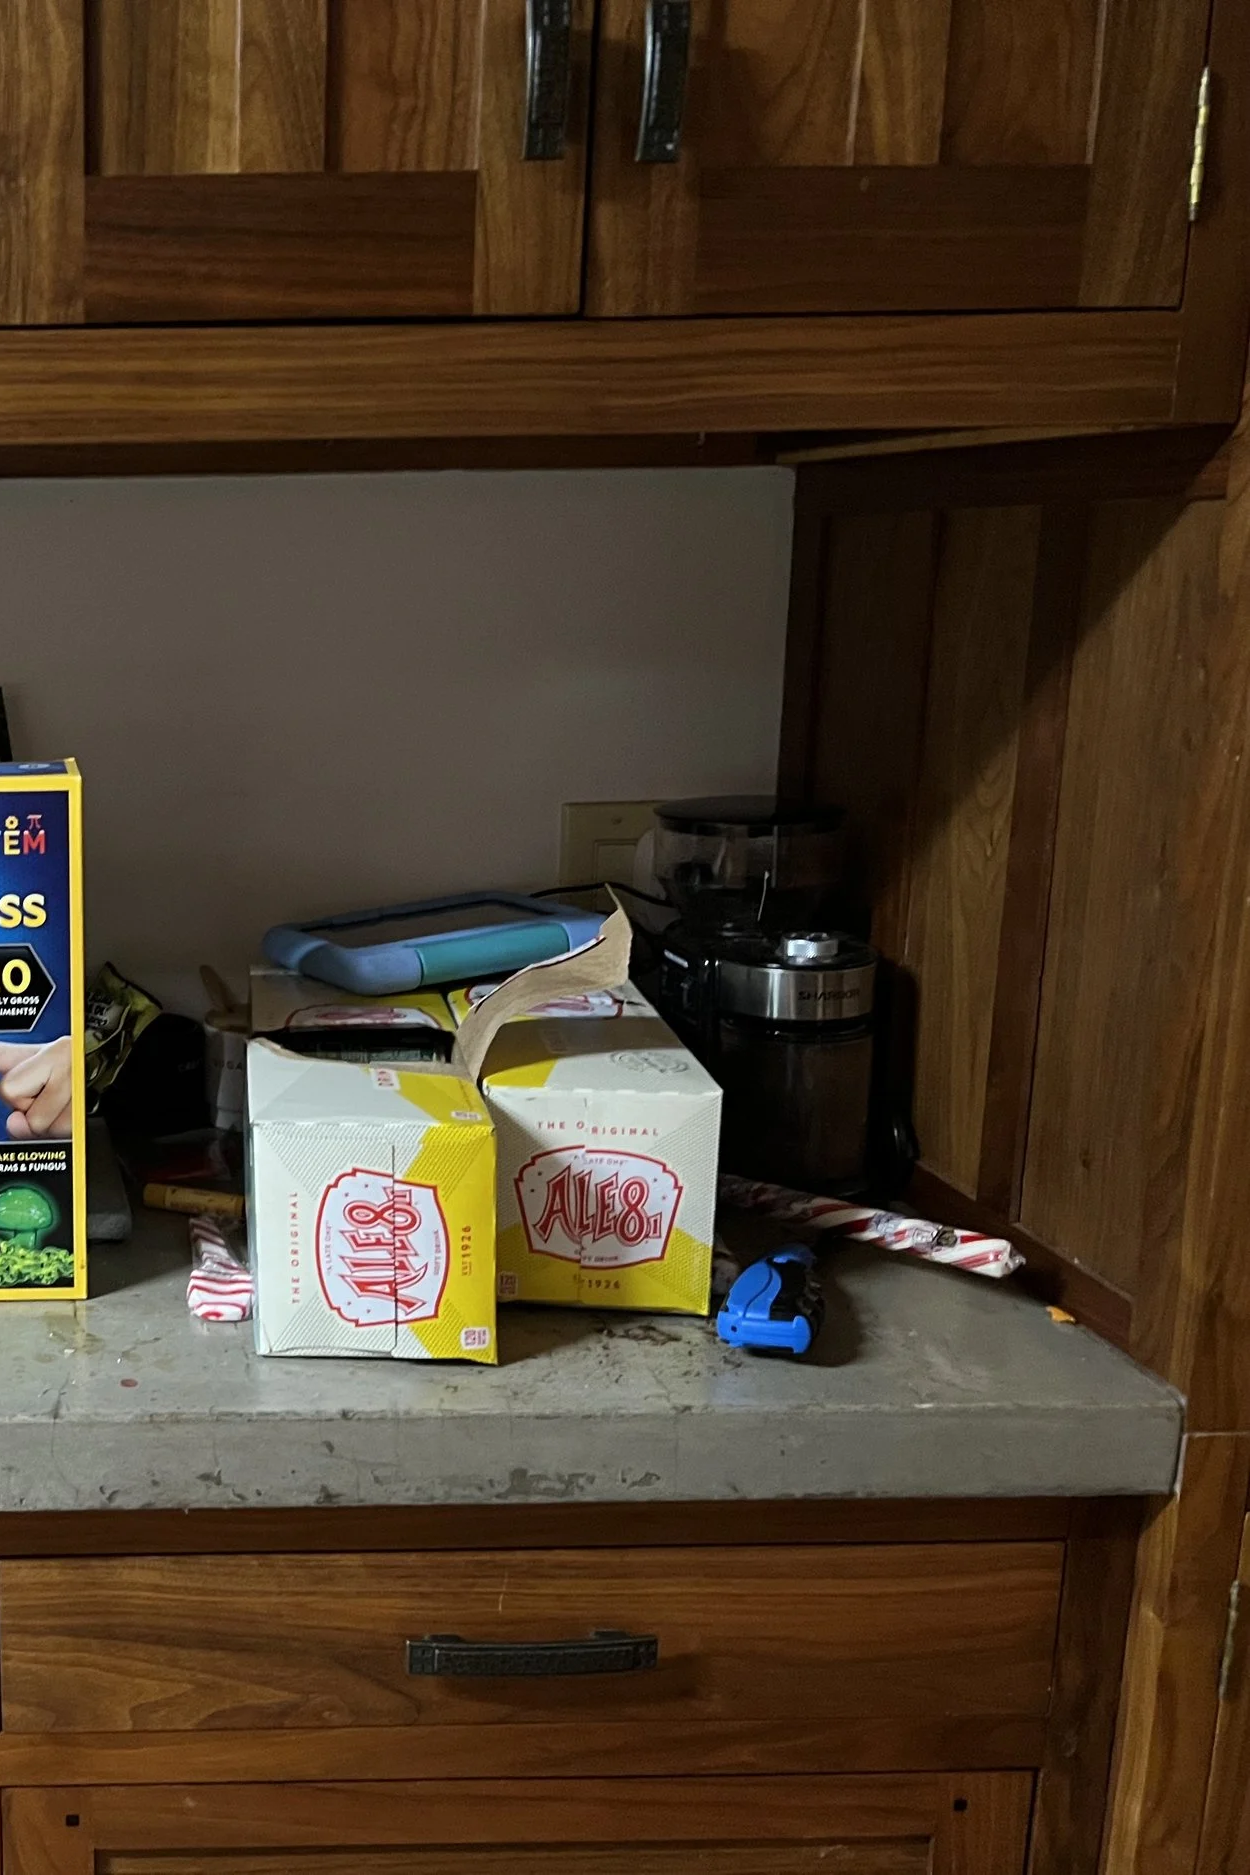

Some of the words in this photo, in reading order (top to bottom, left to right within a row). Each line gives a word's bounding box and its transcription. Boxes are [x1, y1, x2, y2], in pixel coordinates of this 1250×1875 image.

[9, 995, 41, 1005] GROSS
[537, 1121, 566, 1130] THE
[576, 1121, 660, 1137] ORIGINAL
[16, 1150, 67, 1161] GLOWING
[19, 1163, 28, 1173] &
[28, 1161, 68, 1172] FUNGUS
[290, 1192, 300, 1268] ORIGINAL
[461, 1225, 472, 1255] 1926
[291, 1276, 300, 1304] THE
